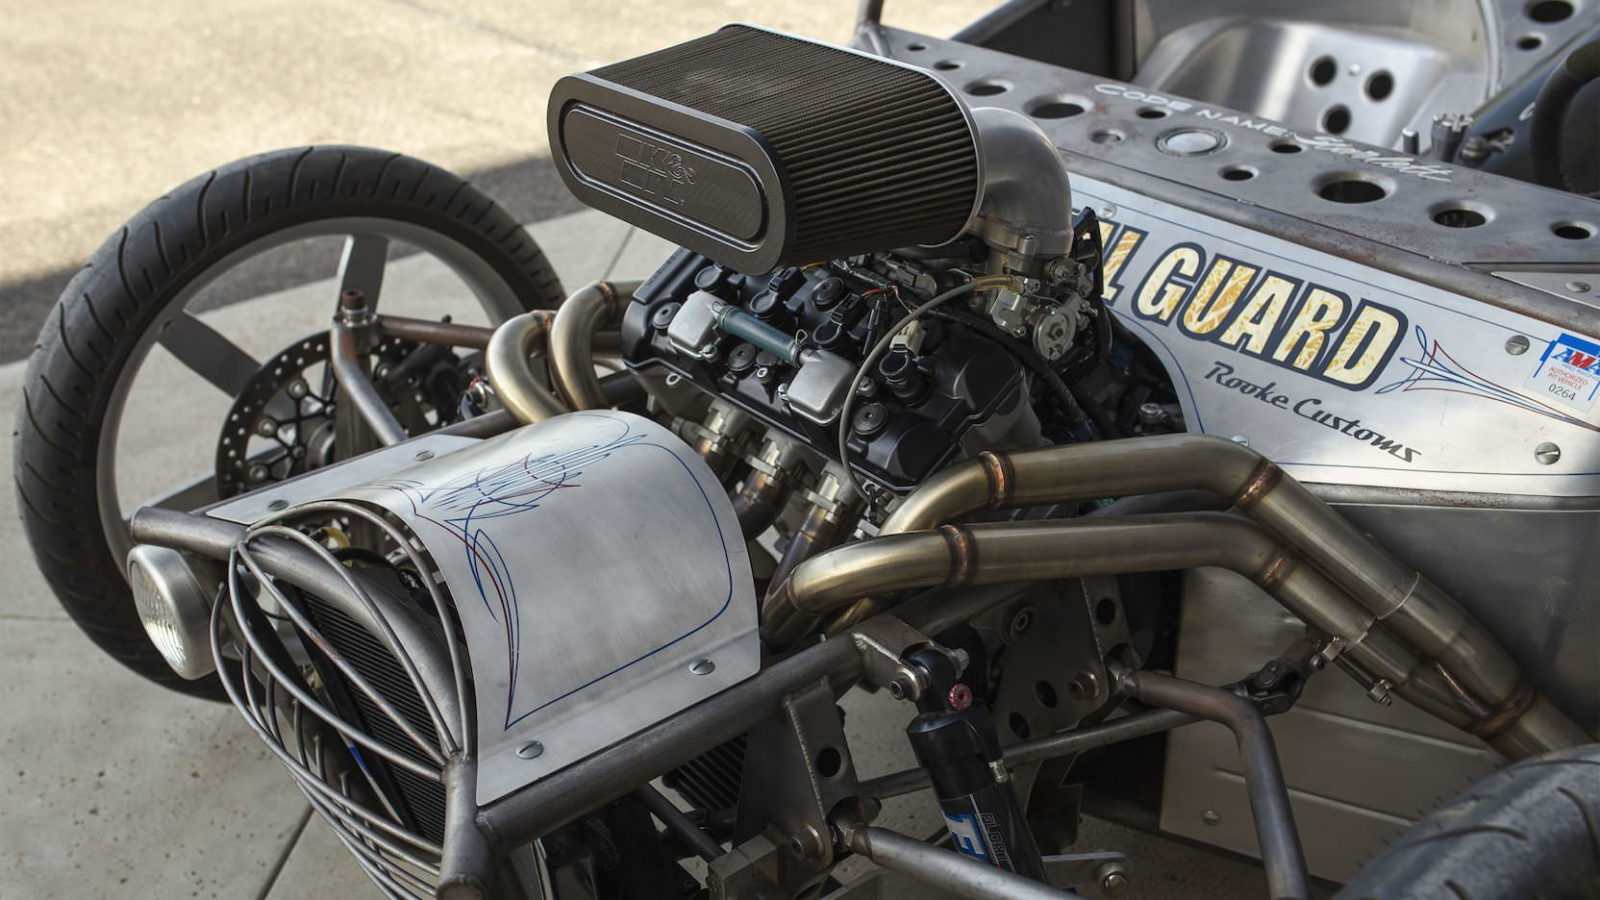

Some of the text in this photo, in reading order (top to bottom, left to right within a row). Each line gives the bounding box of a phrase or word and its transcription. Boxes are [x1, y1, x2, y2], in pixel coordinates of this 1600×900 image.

[1132, 242, 1409, 392] GUARD
[1549, 366, 1589, 386] AUTHORIZED
[1557, 375, 1583, 391] VEHICLE
[1548, 383, 1577, 401] 0264
[1204, 361, 1422, 463] Rooke Customs
